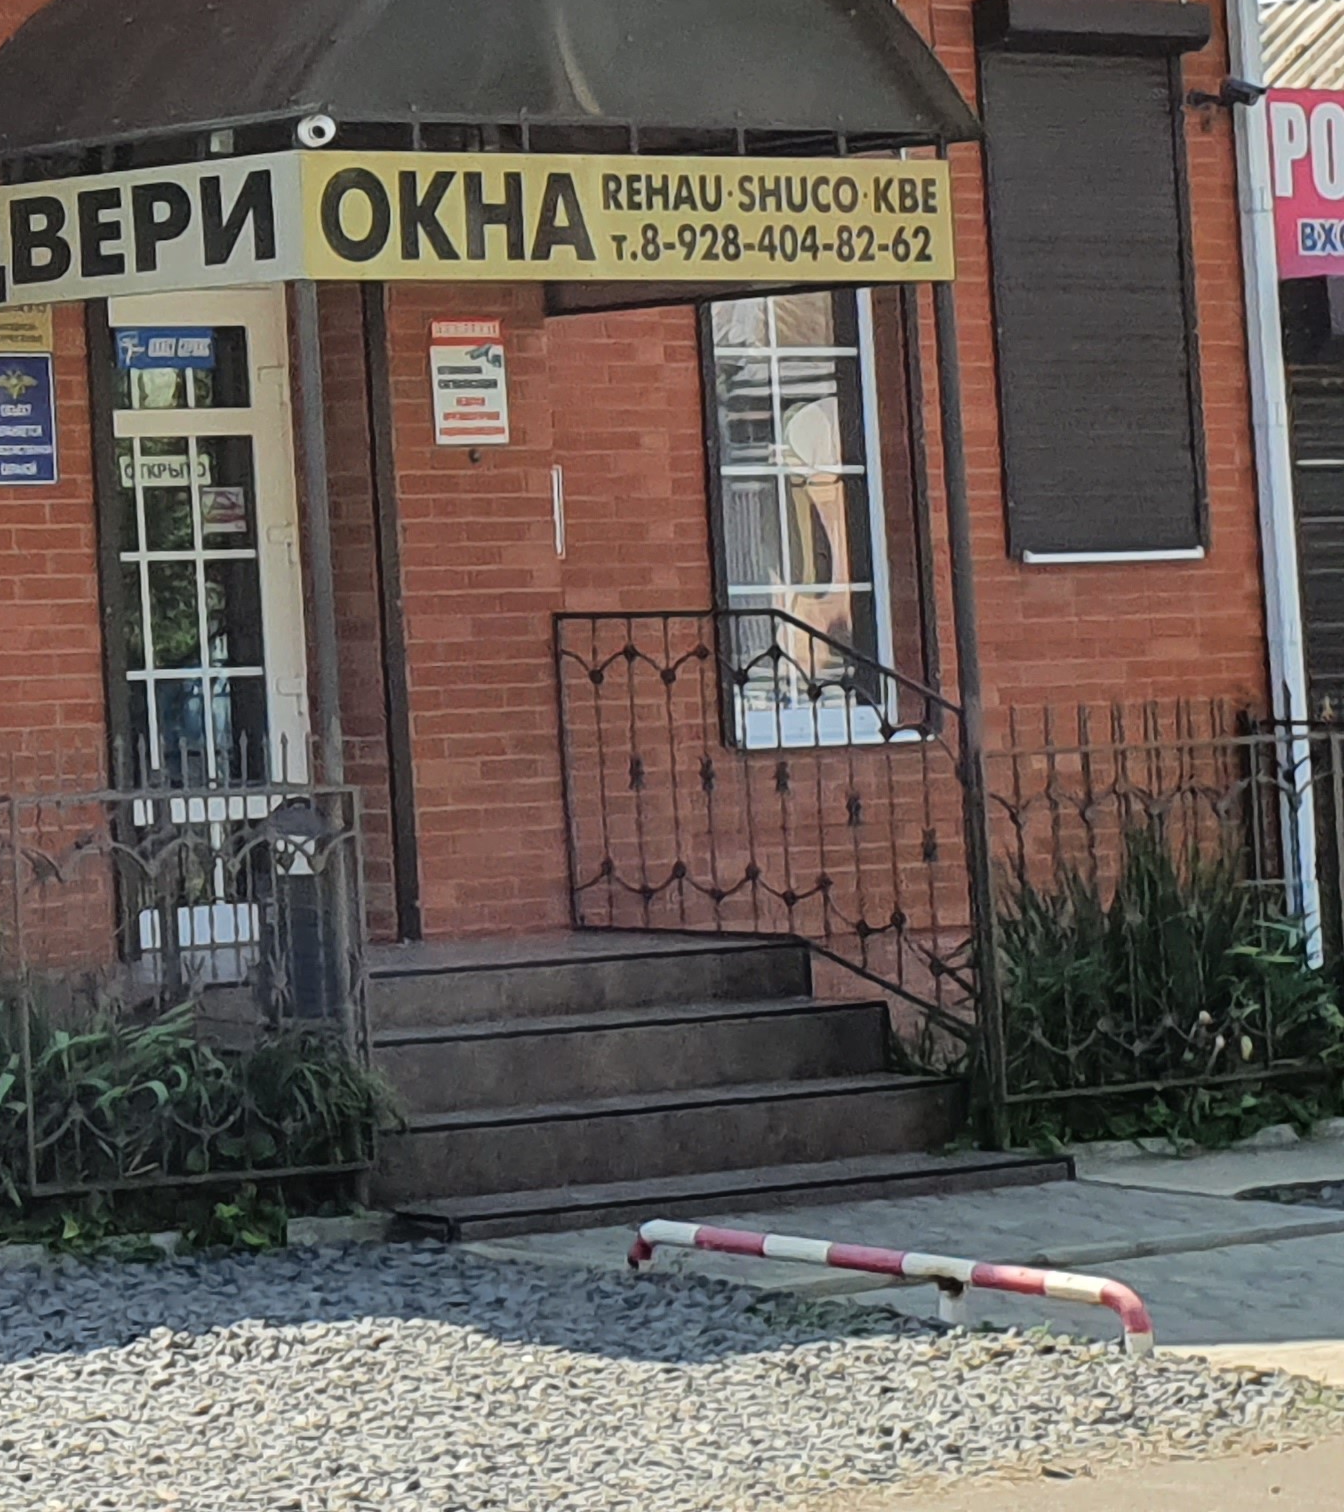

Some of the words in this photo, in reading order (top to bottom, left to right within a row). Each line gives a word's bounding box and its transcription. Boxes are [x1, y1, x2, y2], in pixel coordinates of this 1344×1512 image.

[601, 173, 723, 212] REHAU
[738, 175, 860, 213] SHUCO
[872, 176, 938, 214] KBE
[320, 167, 596, 263] ОКНА
[610, 223, 933, 262] т.8-928-404-82-62
[1301, 219, 1344, 253] ВХ
